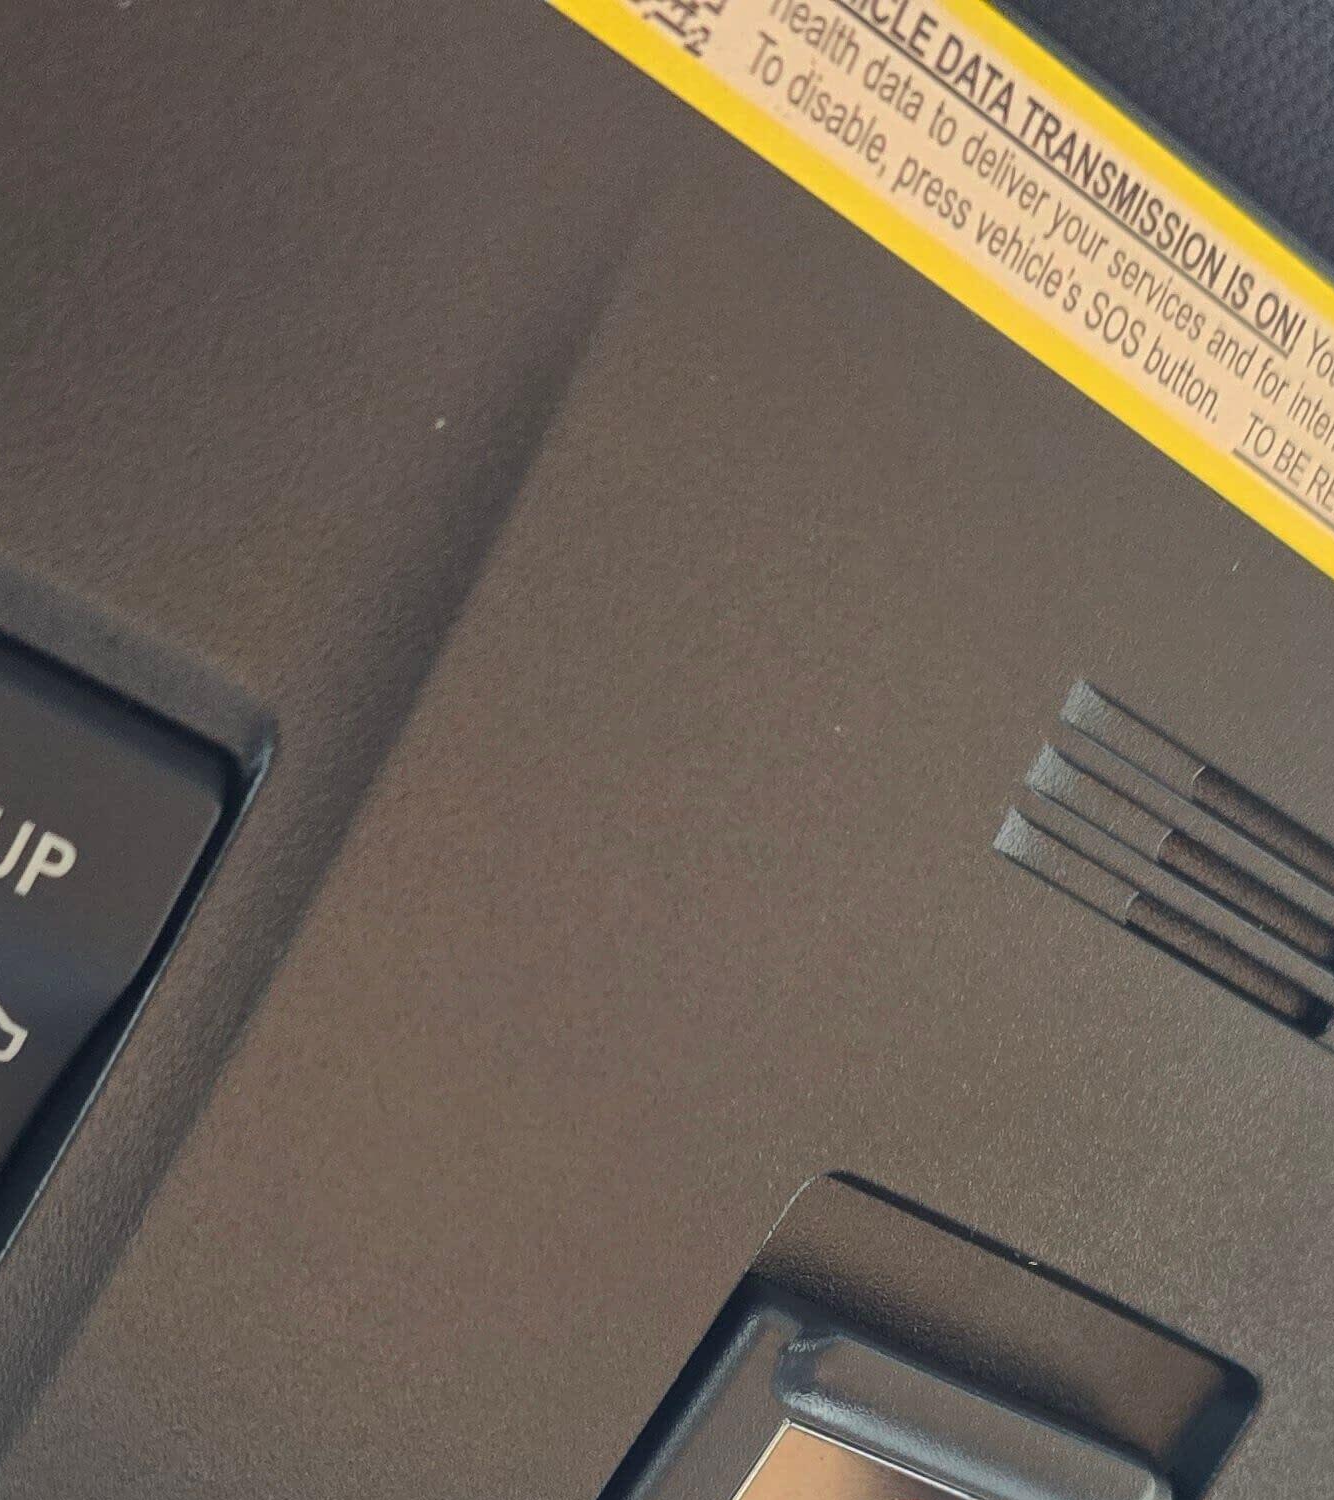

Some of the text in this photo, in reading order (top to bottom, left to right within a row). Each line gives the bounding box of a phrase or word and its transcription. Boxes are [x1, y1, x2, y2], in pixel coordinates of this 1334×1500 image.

[749, 29, 784, 88] To
[786, 68, 887, 179] disable,
[889, 154, 973, 231] press
[974, 211, 1082, 314] vehicle's
[1083, 291, 1147, 360] SOS
[1142, 336, 1220, 425] button.
[1241, 411, 1277, 459] TO
[1272, 439, 1312, 487] BE
[858, 0, 938, 57] CLE
[935, 32, 1015, 125] DATA
[1019, 95, 1227, 290] TRANSMISSION
[1222, 264, 1256, 311] IS
[863, 54, 925, 123] data
[928, 99, 958, 147] to
[961, 130, 1051, 218] deliver
[1043, 199, 1109, 265] your
[1106, 249, 1207, 342] services
[1206, 328, 1260, 381] and
[1252, 355, 1290, 406] for
